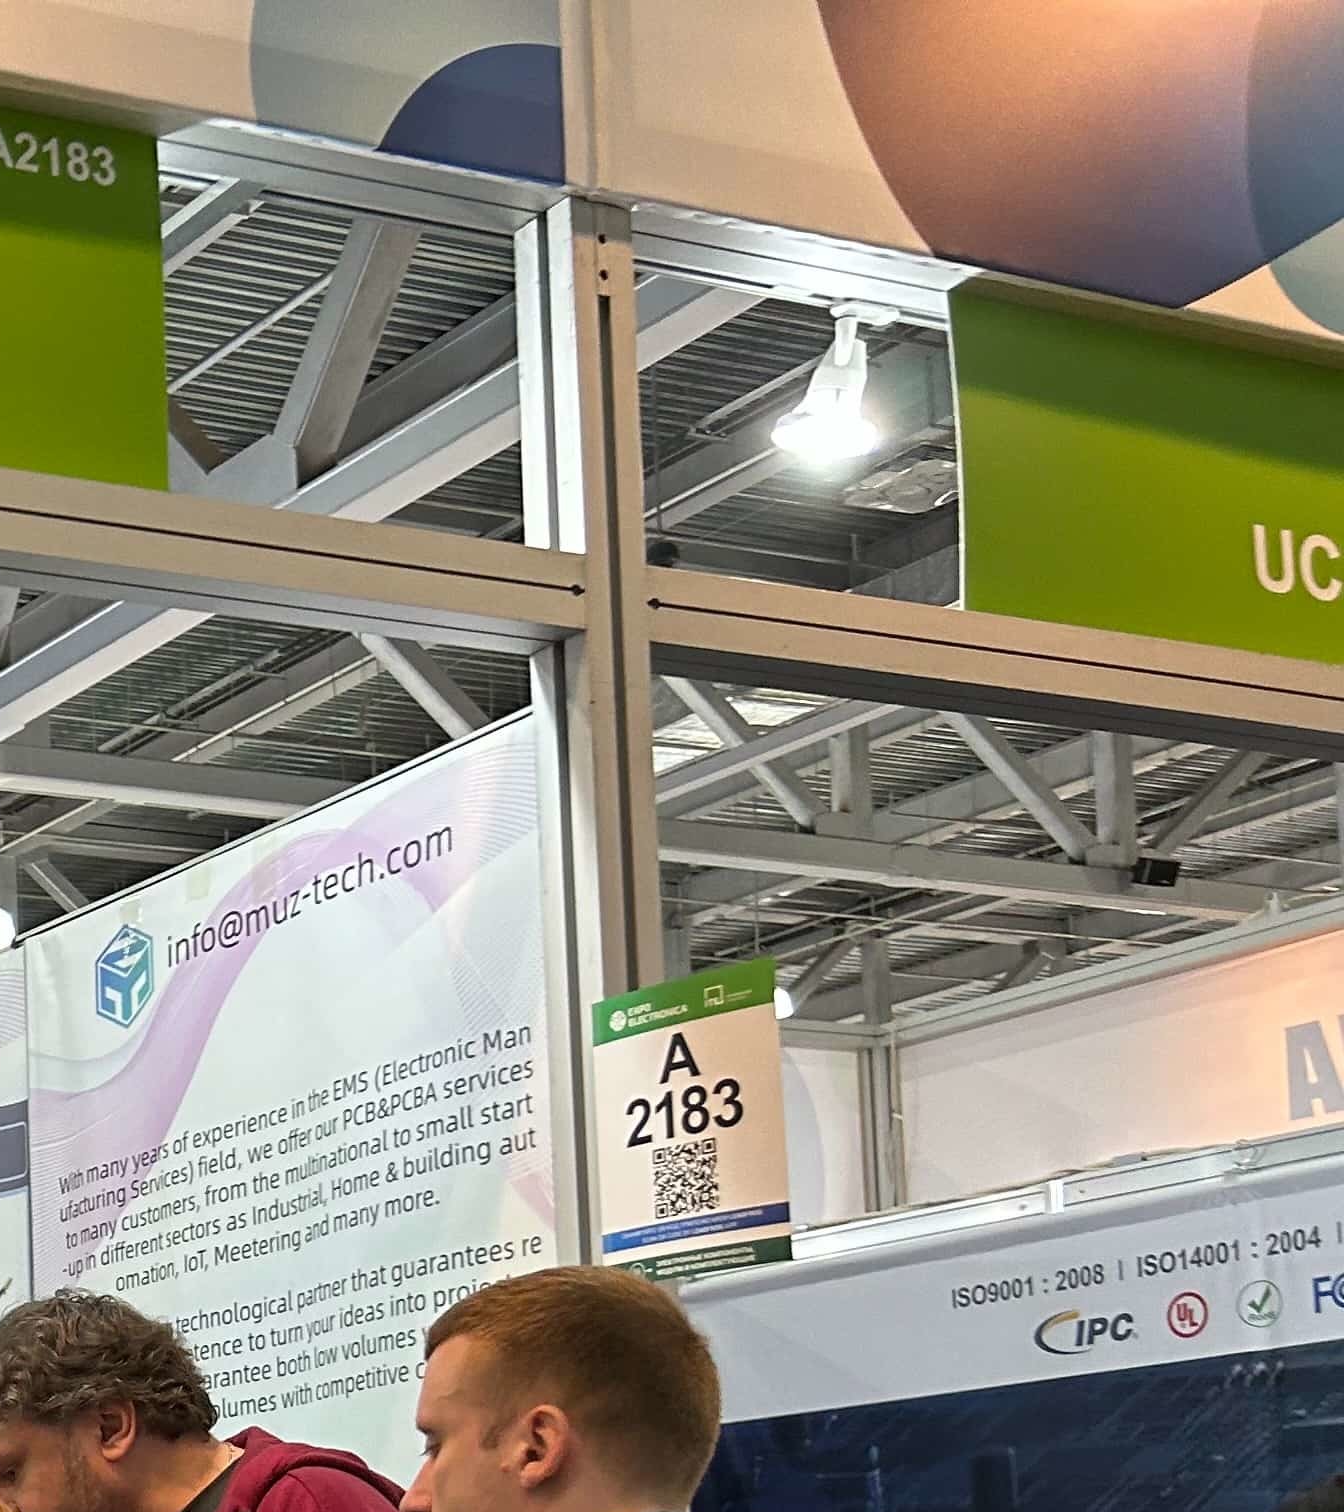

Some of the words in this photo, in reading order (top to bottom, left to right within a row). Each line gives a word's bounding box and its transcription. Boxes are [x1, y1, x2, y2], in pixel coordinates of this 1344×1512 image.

[168, 824, 453, 967] info@muz-tech.com
[659, 1031, 701, 1084] A
[59, 1171, 83, 1194] With
[86, 1156, 128, 1183] many
[132, 1143, 169, 1174] years
[173, 1131, 189, 1155] of
[192, 1106, 287, 1149] experience
[292, 1097, 305, 1120] in
[308, 1088, 329, 1112] the
[333, 1071, 368, 1101] EMS
[375, 1038, 476, 1092] (Electronic
[483, 1026, 532, 1055] Man
[60, 1186, 126, 1222] ufacturing
[130, 1161, 194, 1199] Services)
[198, 1148, 242, 1177] field,
[247, 1143, 273, 1163] we
[278, 1127, 312, 1154] offer
[315, 1116, 339, 1140] our
[343, 1082, 438, 1130] PCB&PCBA
[444, 1059, 534, 1099] services
[625, 1078, 743, 1148] 2183
[65, 1231, 77, 1250] to
[80, 1219, 117, 1244] many
[122, 1195, 200, 1231] customers,
[205, 1181, 247, 1205] from
[253, 1172, 280, 1195] the
[284, 1129, 389, 1185] multinational
[393, 1127, 411, 1149] to
[416, 1105, 475, 1141] small
[481, 1093, 533, 1125] start
[84, 1253, 96, 1272] in
[100, 1234, 163, 1266] different
[166, 1218, 221, 1248] sectors
[226, 1214, 247, 1231] as
[331, 1169, 379, 1200] Home
[385, 1161, 399, 1183] &
[403, 1141, 491, 1178] building
[499, 1127, 536, 1155] aut
[116, 1260, 179, 1291] omation,
[184, 1249, 209, 1273] IoT,
[214, 1230, 301, 1266] Meetering
[304, 1214, 329, 1243] and
[333, 1203, 379, 1233] many
[385, 1188, 440, 1218] more.
[176, 1291, 292, 1335] technological
[297, 1277, 347, 1313] partner
[351, 1265, 387, 1292] that
[391, 1240, 513, 1287] guarantees
[522, 1235, 542, 1257] re
[952, 1277, 1034, 1309] ISO9001
[1056, 1264, 1105, 1293] 2008
[1137, 1240, 1241, 1277] ISO14001
[1266, 1227, 1321, 1256] 2004
[193, 1340, 242, 1363] tence
[248, 1332, 265, 1351] to
[270, 1326, 304, 1347] turn
[306, 1314, 334, 1345] your
[339, 1302, 385, 1329] ideas
[389, 1291, 425, 1316] into
[205, 1362, 272, 1391] arantee
[276, 1352, 311, 1377] both
[314, 1346, 337, 1368] low
[341, 1329, 416, 1360] volumes
[1074, 1312, 1136, 1347] IPC
[281, 1386, 313, 1409] with
[315, 1364, 409, 1401] competitive
